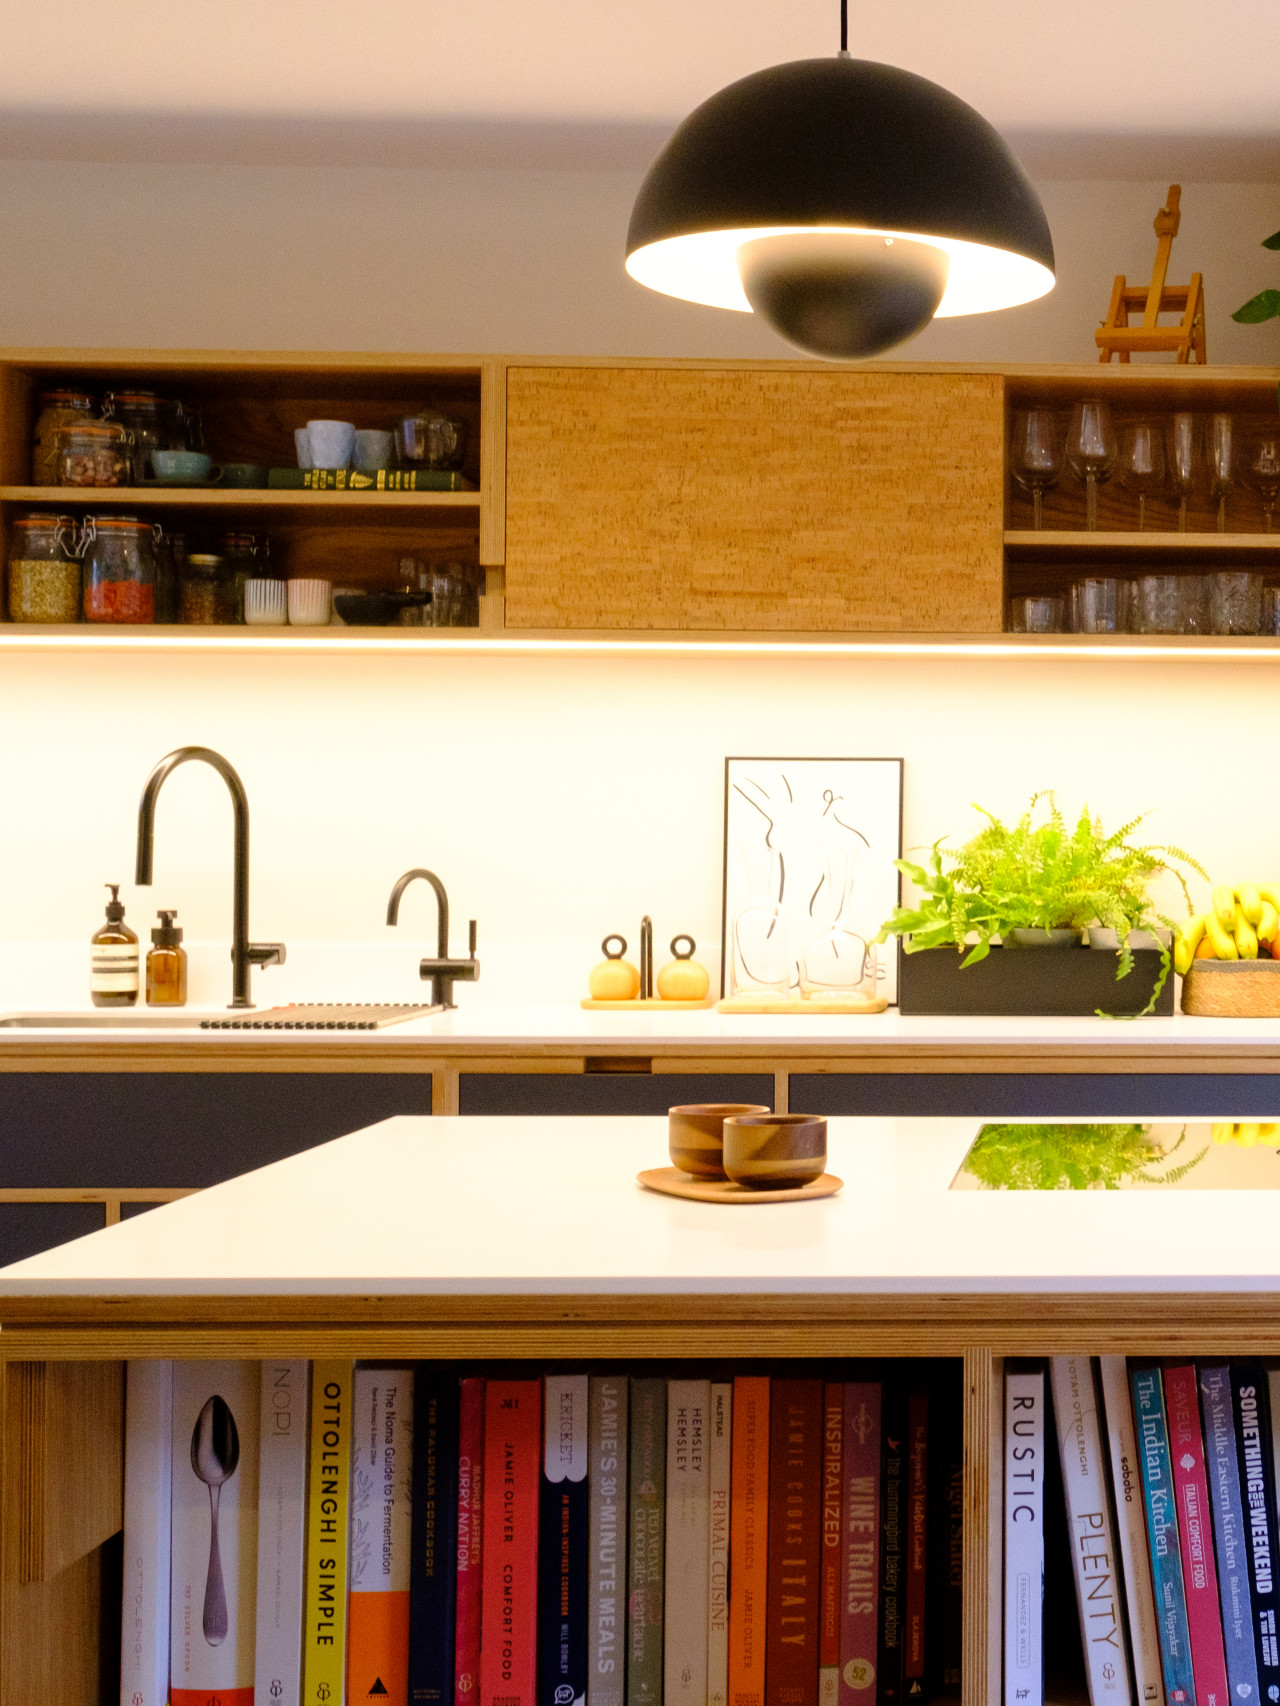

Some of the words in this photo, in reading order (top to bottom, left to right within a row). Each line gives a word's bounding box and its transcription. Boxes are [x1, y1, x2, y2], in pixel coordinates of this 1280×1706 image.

[273, 1368, 290, 1436] NOPI
[386, 1387, 396, 1408] The
[1068, 1358, 1080, 1398] YOTAM
[1137, 1377, 1154, 1407] The
[1209, 1374, 1222, 1400] The
[384, 1411, 395, 1444] Noma
[428, 1399, 436, 1424] THE
[560, 1393, 572, 1464] KRICKET
[747, 1401, 756, 1434] SUPER
[787, 1405, 804, 1467] JAMIE
[1173, 1382, 1191, 1444] SAVEUR
[1211, 1403, 1227, 1454] Middle
[320, 1382, 342, 1544] OTTOLENGHI
[383, 1448, 395, 1482] Guide
[427, 1430, 436, 1496] PALOMAR
[504, 1442, 514, 1484] JAMIE
[677, 1408, 687, 1472] HEMSLEY
[691, 1408, 702, 1472] HEMSLEY
[746, 1438, 755, 1469] FOOD
[1013, 1396, 1034, 1522] RUSTIC
[1073, 1402, 1088, 1476] OTTOLENGHI
[1142, 1413, 1166, 1481] Indian
[1239, 1386, 1264, 1492] SOMETHING
[384, 1484, 393, 1496] to
[459, 1457, 470, 1507] CURRY
[824, 1407, 841, 1546] INSPIRALIZED
[888, 1458, 901, 1474] the
[1215, 1457, 1232, 1509] Eastern
[503, 1490, 514, 1542] OLIVER
[746, 1472, 755, 1514] FAMILY
[787, 1482, 804, 1545] COOKS
[849, 1476, 875, 1532] WINE
[883, 1480, 901, 1551] hummingbird
[1184, 1484, 1199, 1517] ITALIAN
[382, 1499, 394, 1574] Fermentation
[426, 1502, 434, 1577] COOKBOOK
[458, 1513, 469, 1570] NATION
[712, 1490, 726, 1554] PRIMAL
[745, 1517, 754, 1570] CLASSICS
[1150, 1489, 1171, 1556] Kitchen
[1187, 1520, 1202, 1561] COMFORT
[1219, 1512, 1238, 1570] Kitchen
[883, 1556, 900, 1592] bakery
[1192, 1564, 1206, 1588] FOOD
[1250, 1508, 1273, 1593] WEEKEND
[317, 1558, 336, 1646] SIMPLE
[503, 1564, 513, 1634] COMFORT
[712, 1562, 725, 1631] CUISINE
[781, 1559, 807, 1646] ITALY
[848, 1541, 873, 1615] TRAILS
[1020, 1578, 1028, 1625] FERNANDEZ
[1077, 1512, 1119, 1649] PLENTY
[744, 1589, 753, 1624] JAMIE
[885, 1596, 899, 1648] cookbook
[1260, 1621, 1269, 1634] TIM
[1267, 1610, 1276, 1634] SIMON
[502, 1640, 513, 1680] FOOD
[743, 1627, 753, 1668] OLIVER
[1262, 1636, 1271, 1665] LOVEJOY
[1269, 1636, 1278, 1666] RIMMER
[851, 1666, 868, 1682] 52
